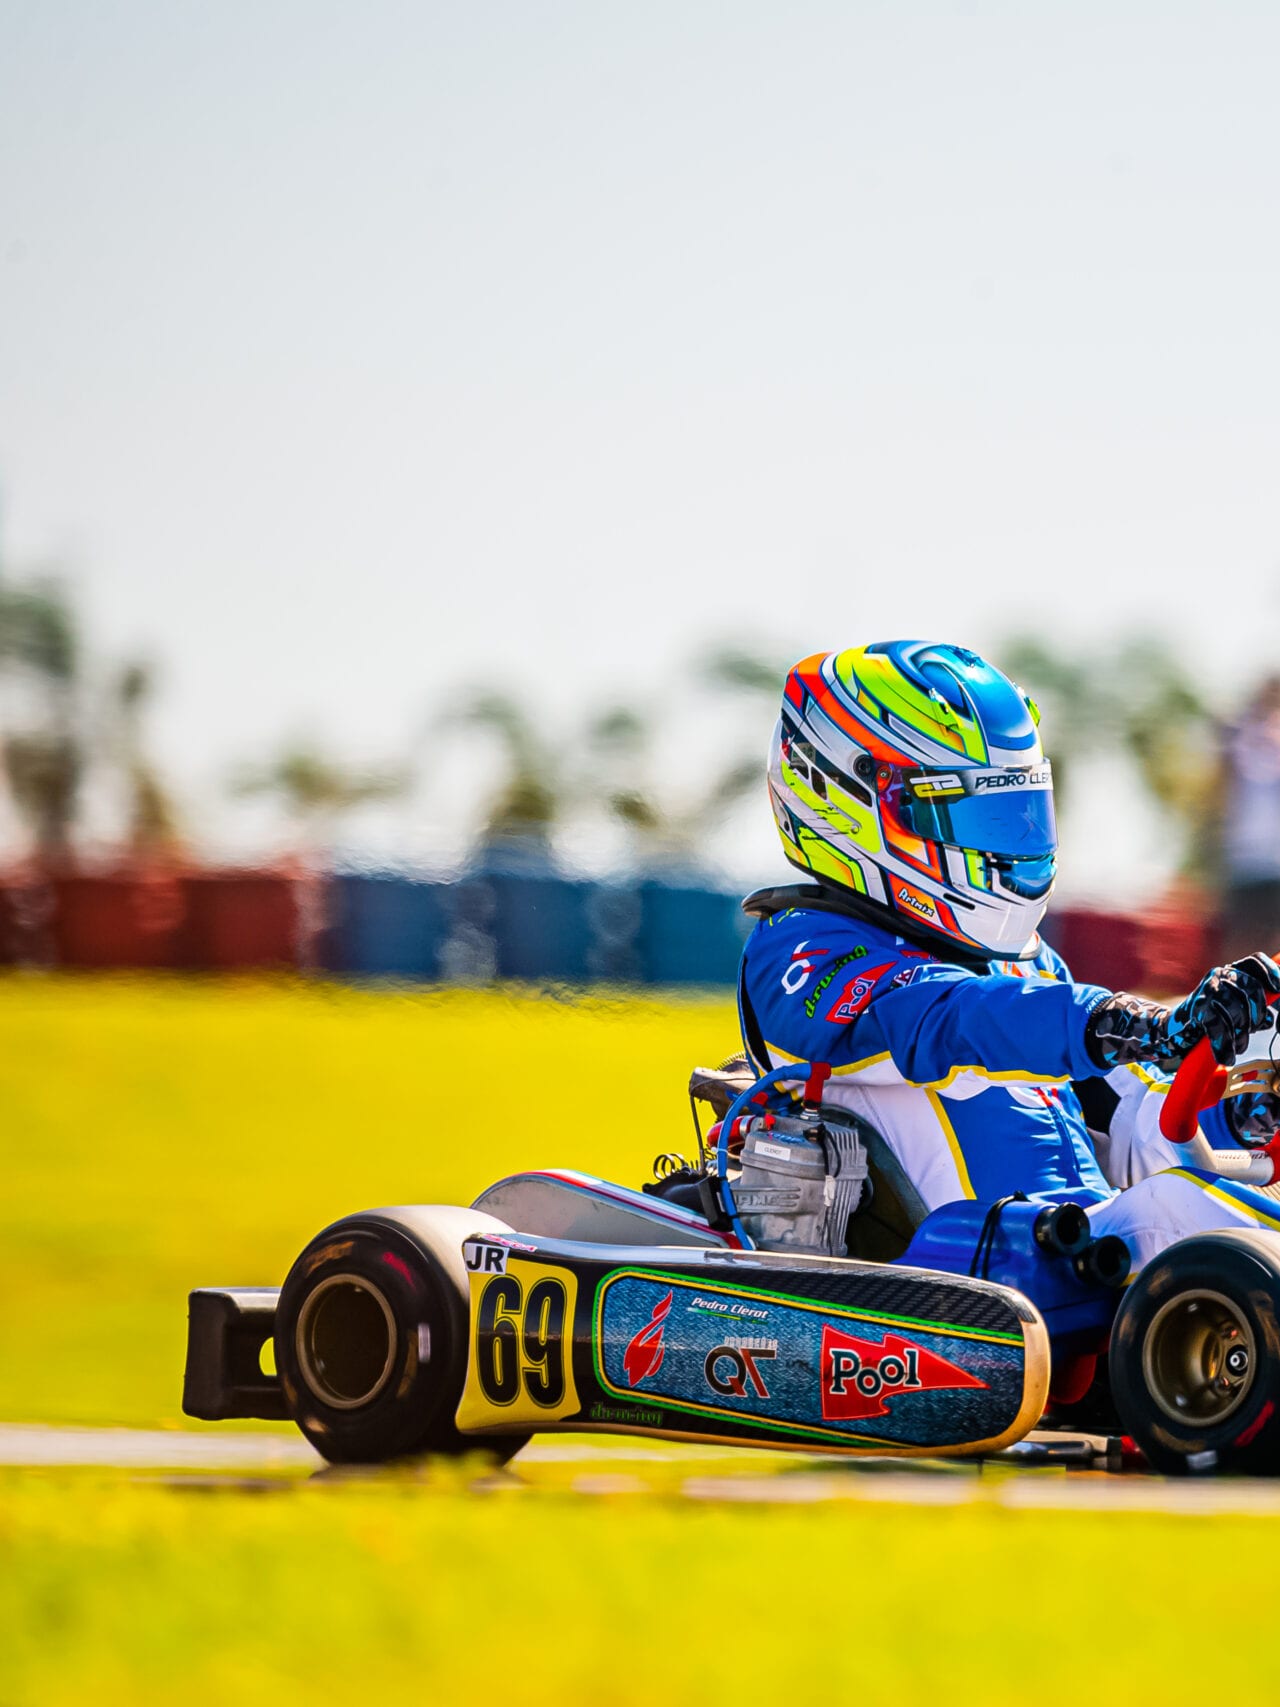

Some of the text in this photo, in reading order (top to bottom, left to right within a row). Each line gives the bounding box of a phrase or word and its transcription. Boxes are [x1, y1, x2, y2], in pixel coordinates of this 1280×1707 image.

[975, 774, 1026, 789] PEDRO
[466, 1245, 504, 1272] JR
[691, 1297, 769, 1319] Pedro Clerot
[476, 1273, 567, 1409] 69
[829, 1348, 922, 1397] Pool
